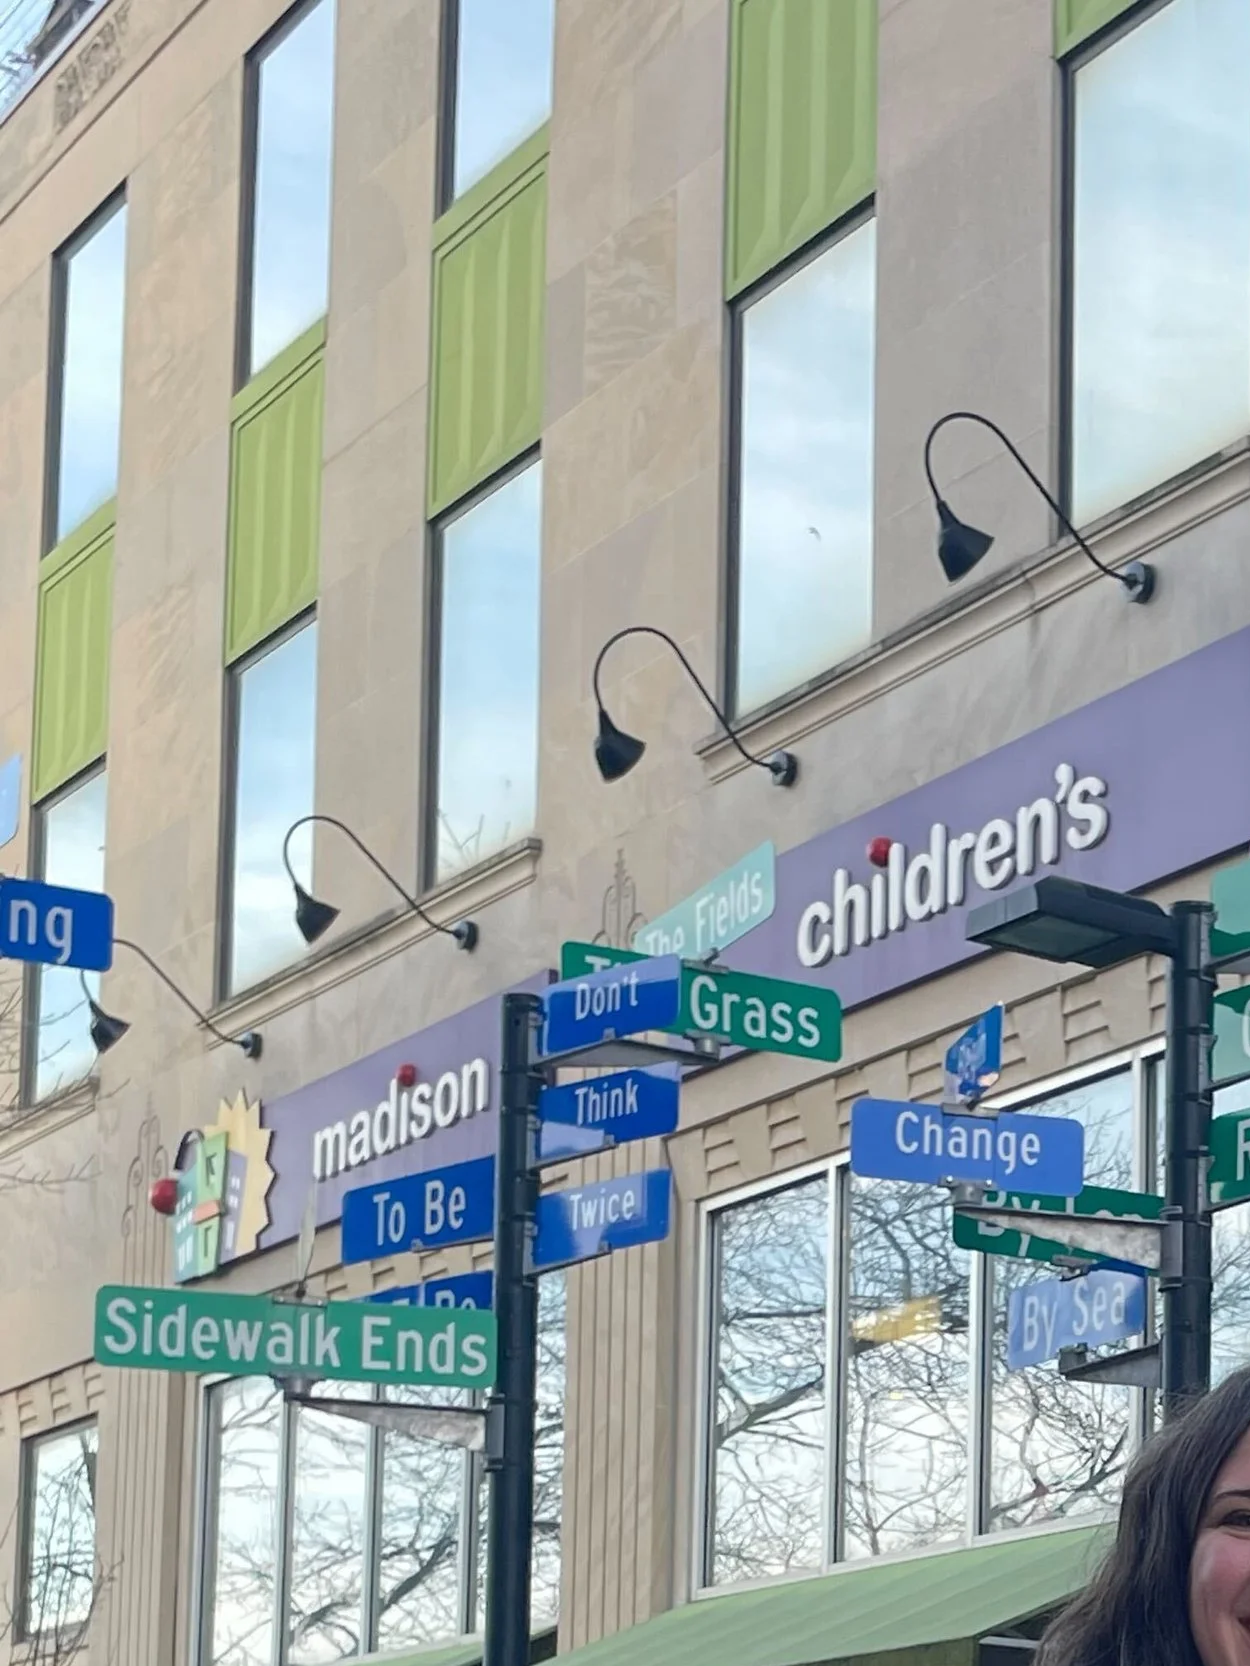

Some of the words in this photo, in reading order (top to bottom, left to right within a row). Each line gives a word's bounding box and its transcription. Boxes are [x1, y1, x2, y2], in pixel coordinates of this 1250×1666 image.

[797, 763, 1107, 967] children's
[696, 872, 762, 952] Fields
[576, 971, 638, 1020] Don't
[690, 975, 820, 1048] Grass
[313, 1056, 489, 1180] madison
[575, 1078, 638, 1126] Think
[896, 1112, 1041, 1174] Change
[373, 1192, 406, 1247] To
[425, 1181, 465, 1234] Be
[570, 1187, 635, 1230] Twice
[104, 1298, 340, 1367] Sidewalk
[362, 1315, 488, 1376] Ends
[1023, 1296, 1057, 1358] By
[1072, 1278, 1124, 1336] Sea
